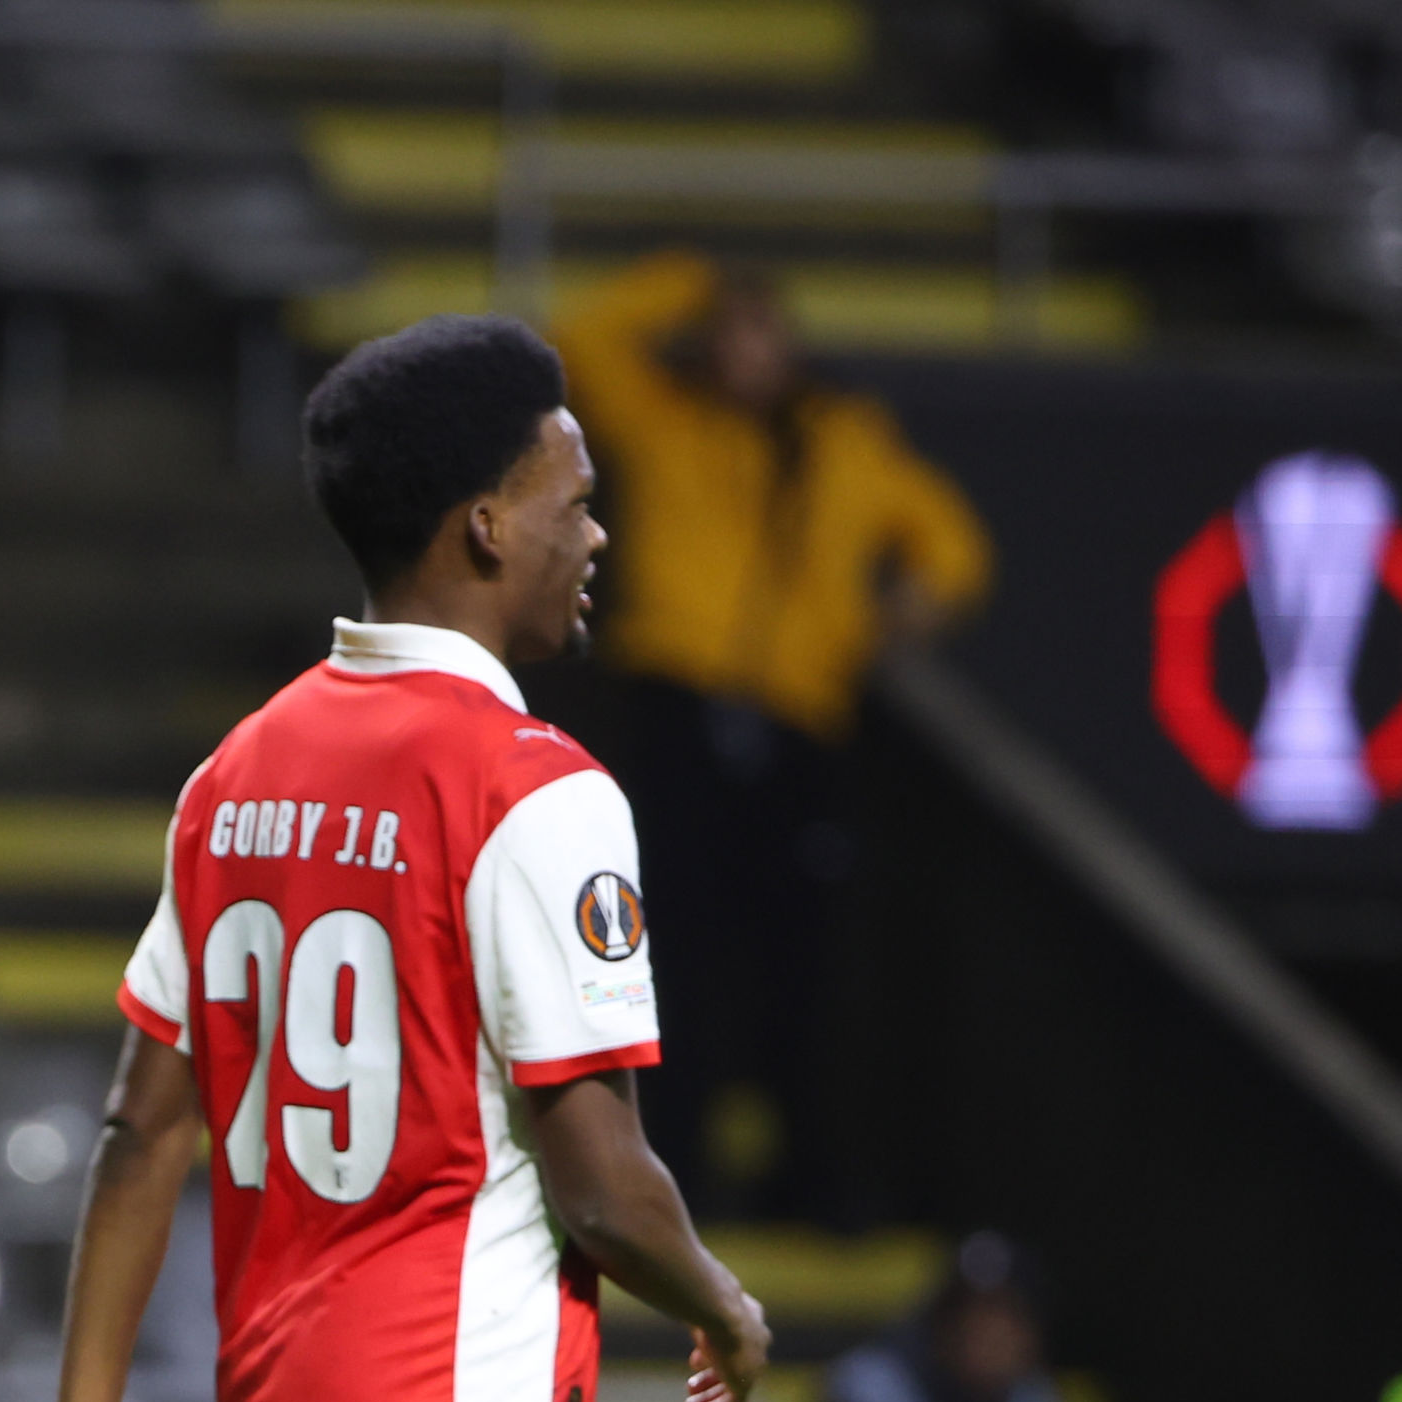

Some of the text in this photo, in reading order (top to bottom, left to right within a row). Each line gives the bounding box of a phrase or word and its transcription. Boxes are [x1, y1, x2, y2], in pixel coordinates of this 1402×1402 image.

[209, 799, 408, 875] GORBY J.B.
[203, 899, 401, 1204] 29
